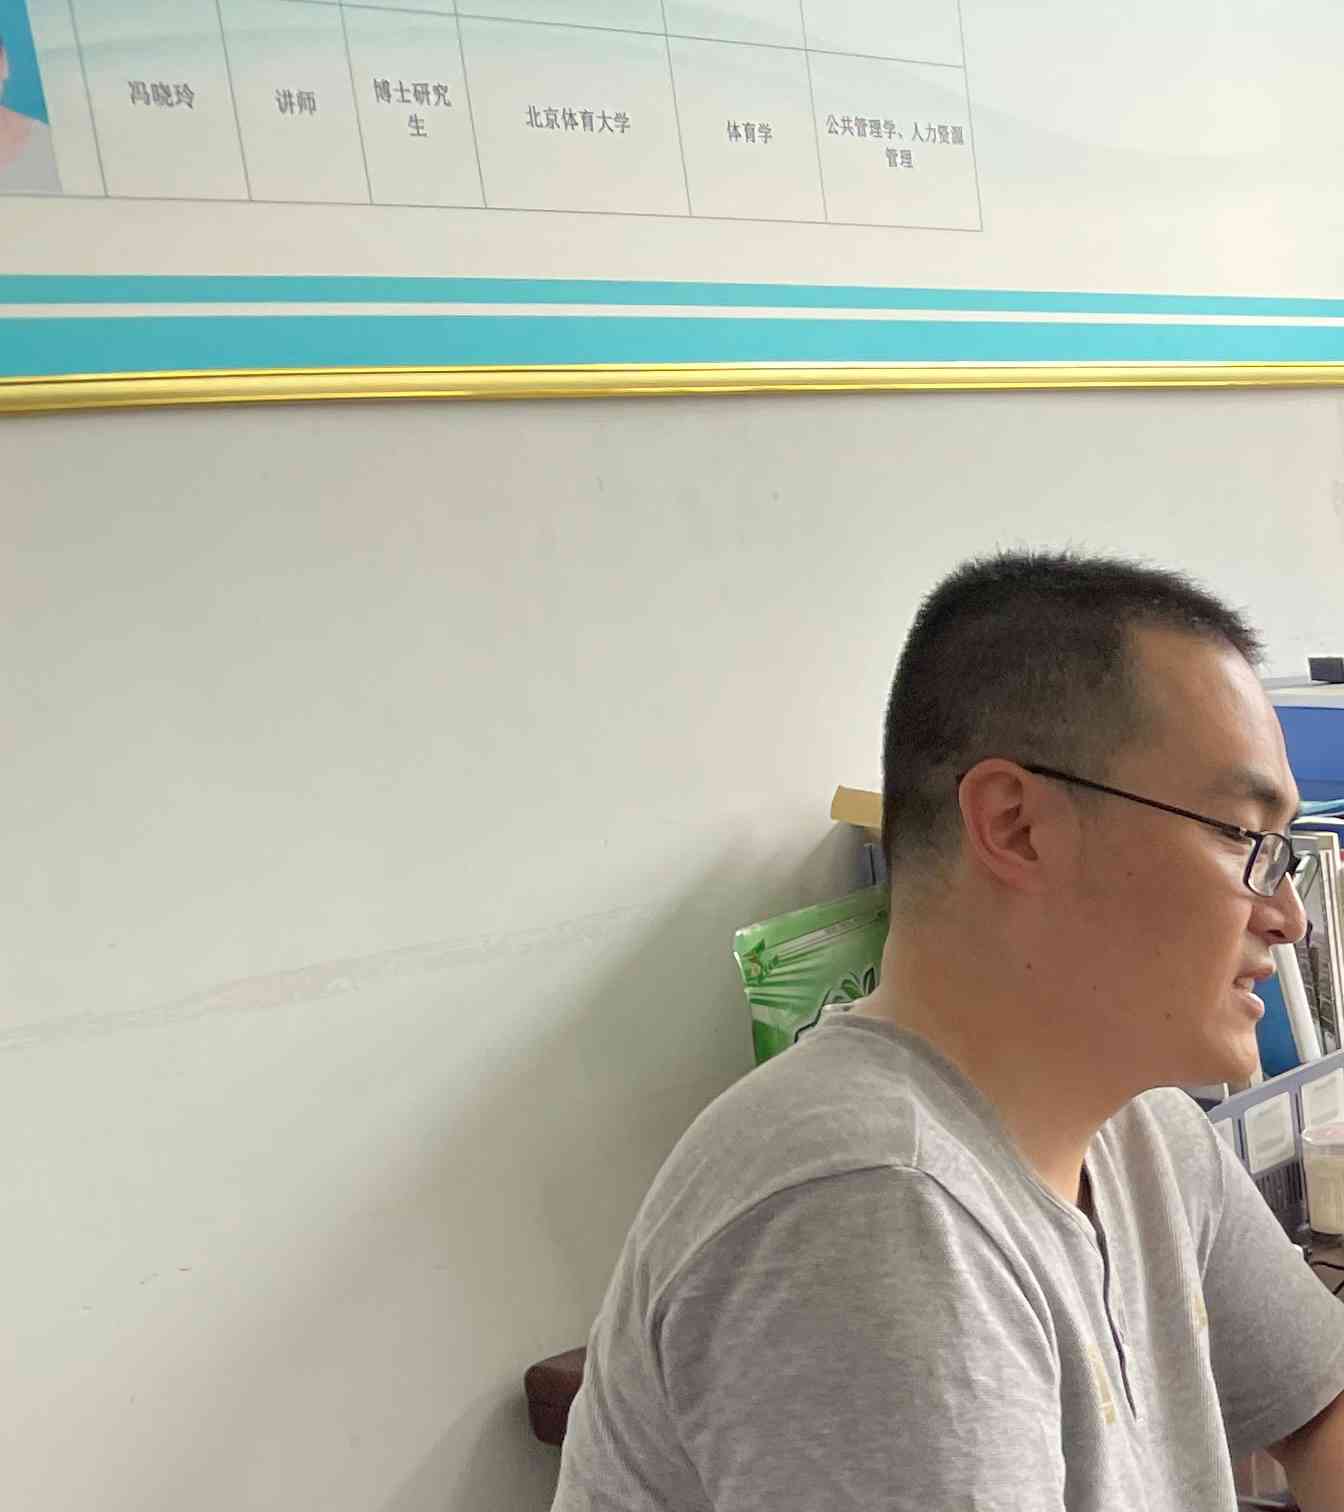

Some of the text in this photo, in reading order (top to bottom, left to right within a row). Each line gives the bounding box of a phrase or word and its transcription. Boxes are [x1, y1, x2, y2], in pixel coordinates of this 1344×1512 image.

[275, 89, 317, 115] 讲师
[373, 78, 452, 107] 博士研究
[407, 113, 428, 137] 生
[525, 104, 632, 134] 北京体育大学
[726, 119, 773, 145] 体育学
[825, 113, 966, 146] 公共管理学、人力资源
[885, 147, 914, 169] 管理
